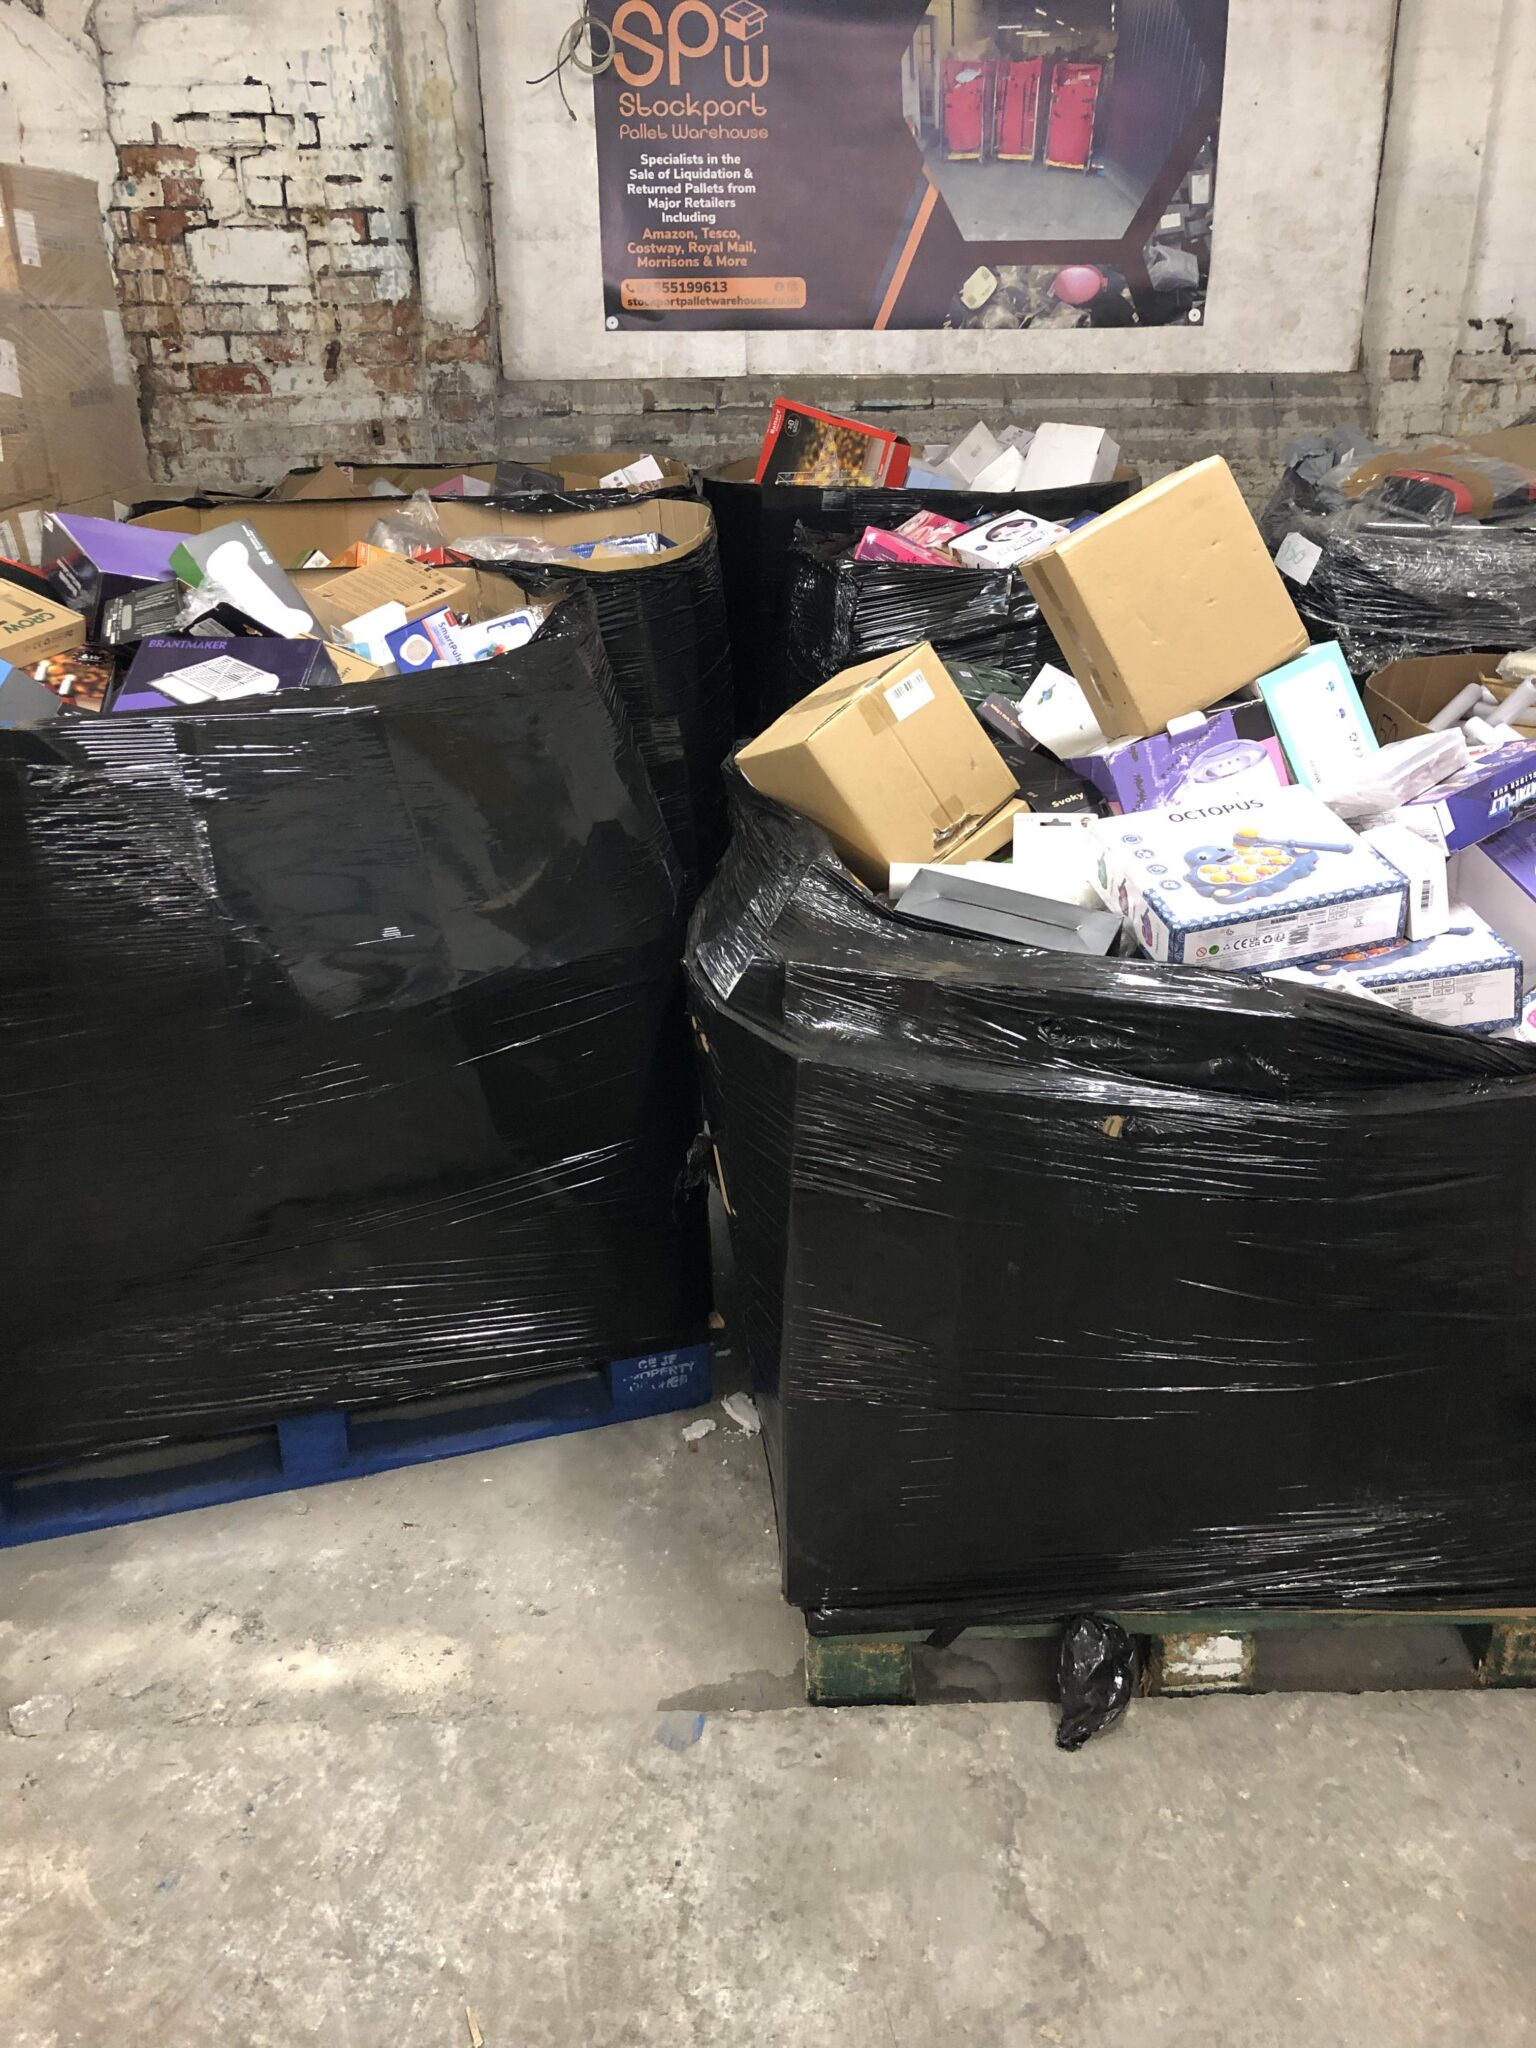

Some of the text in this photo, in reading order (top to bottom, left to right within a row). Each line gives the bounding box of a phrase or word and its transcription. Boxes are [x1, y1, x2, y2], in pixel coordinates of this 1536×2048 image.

[619, 92, 768, 125] Stockport
[619, 124, 769, 140] Pallet Warehouse
[640, 153, 741, 166] Specialists in the
[629, 168, 754, 182] Sale of Liquidation &
[627, 183, 757, 195] Returned Pallets from
[648, 197, 736, 211] Major Retailers
[661, 211, 717, 225] Including
[642, 227, 741, 241] Amazon, Tesco,
[627, 241, 757, 255] Costway, Royal Mail,
[637, 255, 747, 268] Morrisons & More
[3, 612, 56, 634] GROW
[148, 639, 228, 650] BRANTMAKER
[1051, 791, 1085, 809] Svoky
[1168, 798, 1265, 823] OCTOPUS
